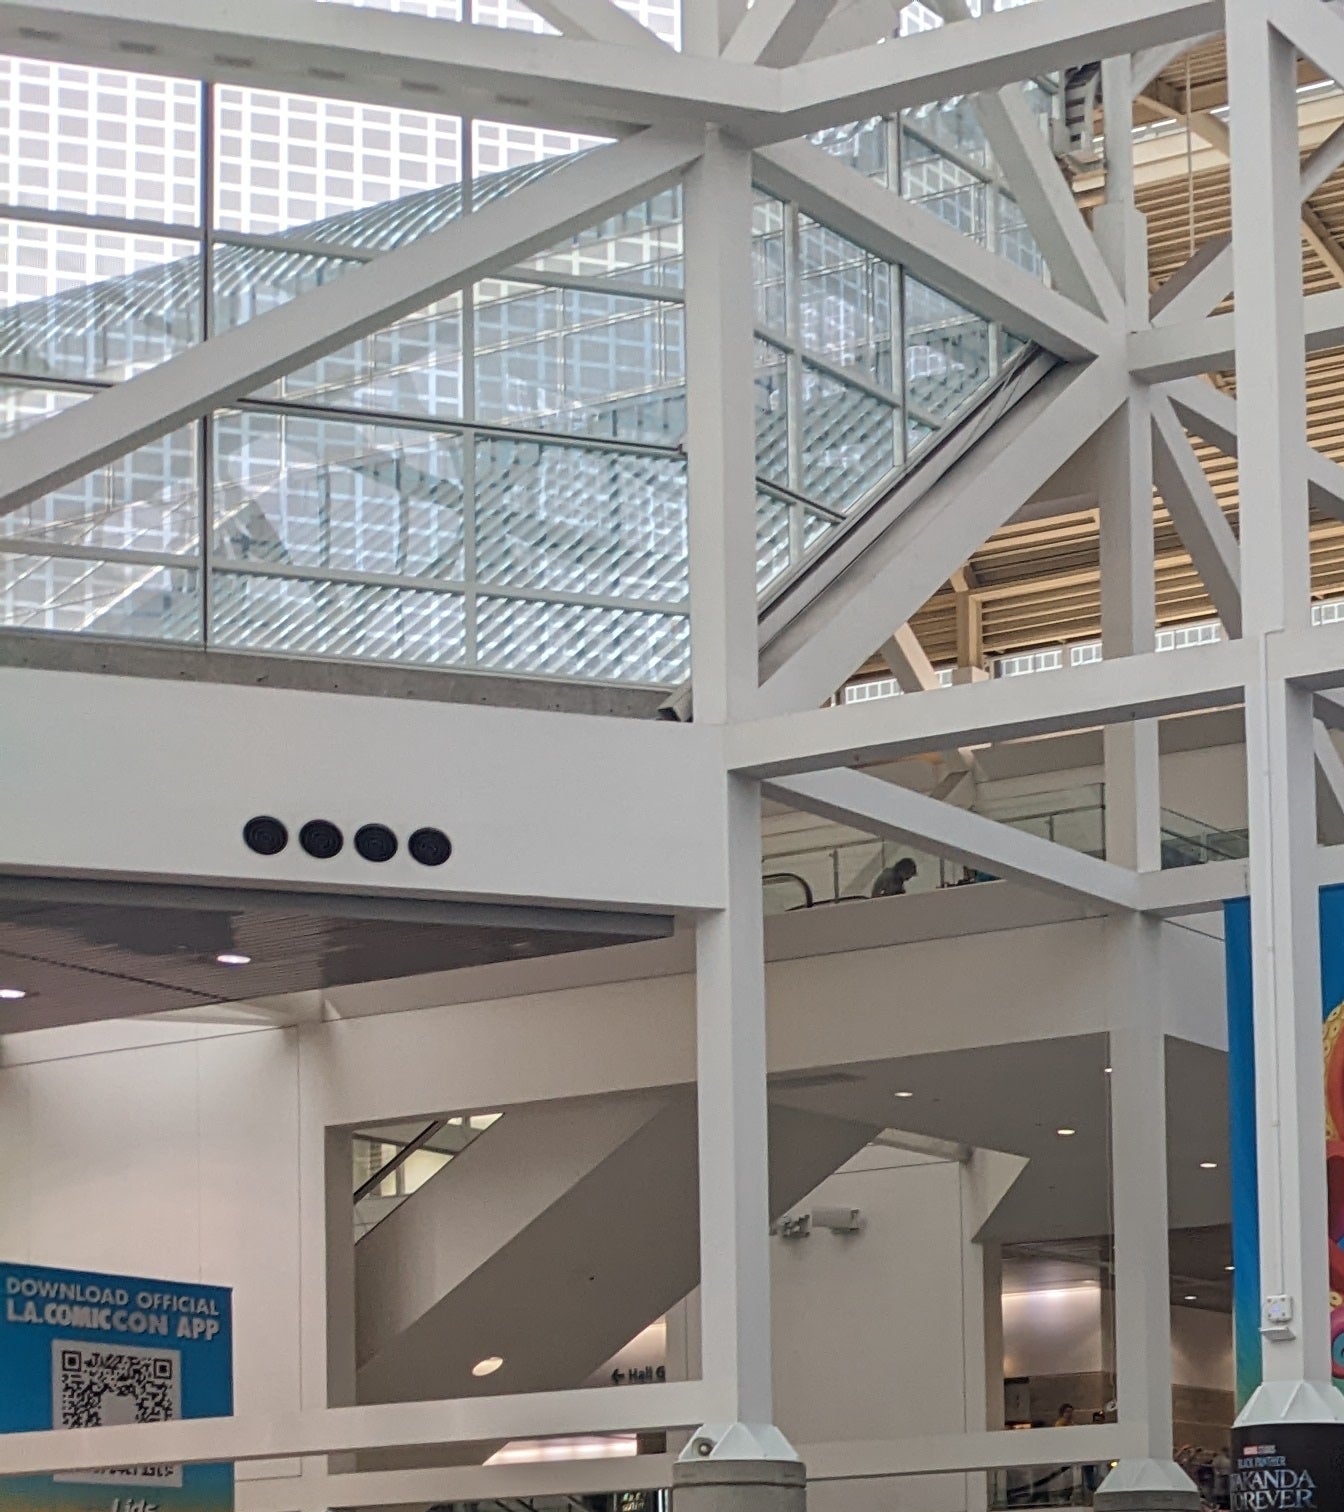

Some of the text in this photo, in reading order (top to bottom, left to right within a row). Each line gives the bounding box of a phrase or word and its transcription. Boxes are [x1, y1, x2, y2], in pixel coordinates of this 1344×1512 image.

[6, 1277, 220, 1316] DOWNLOAD OFFICIAL
[177, 1317, 220, 1341] APP
